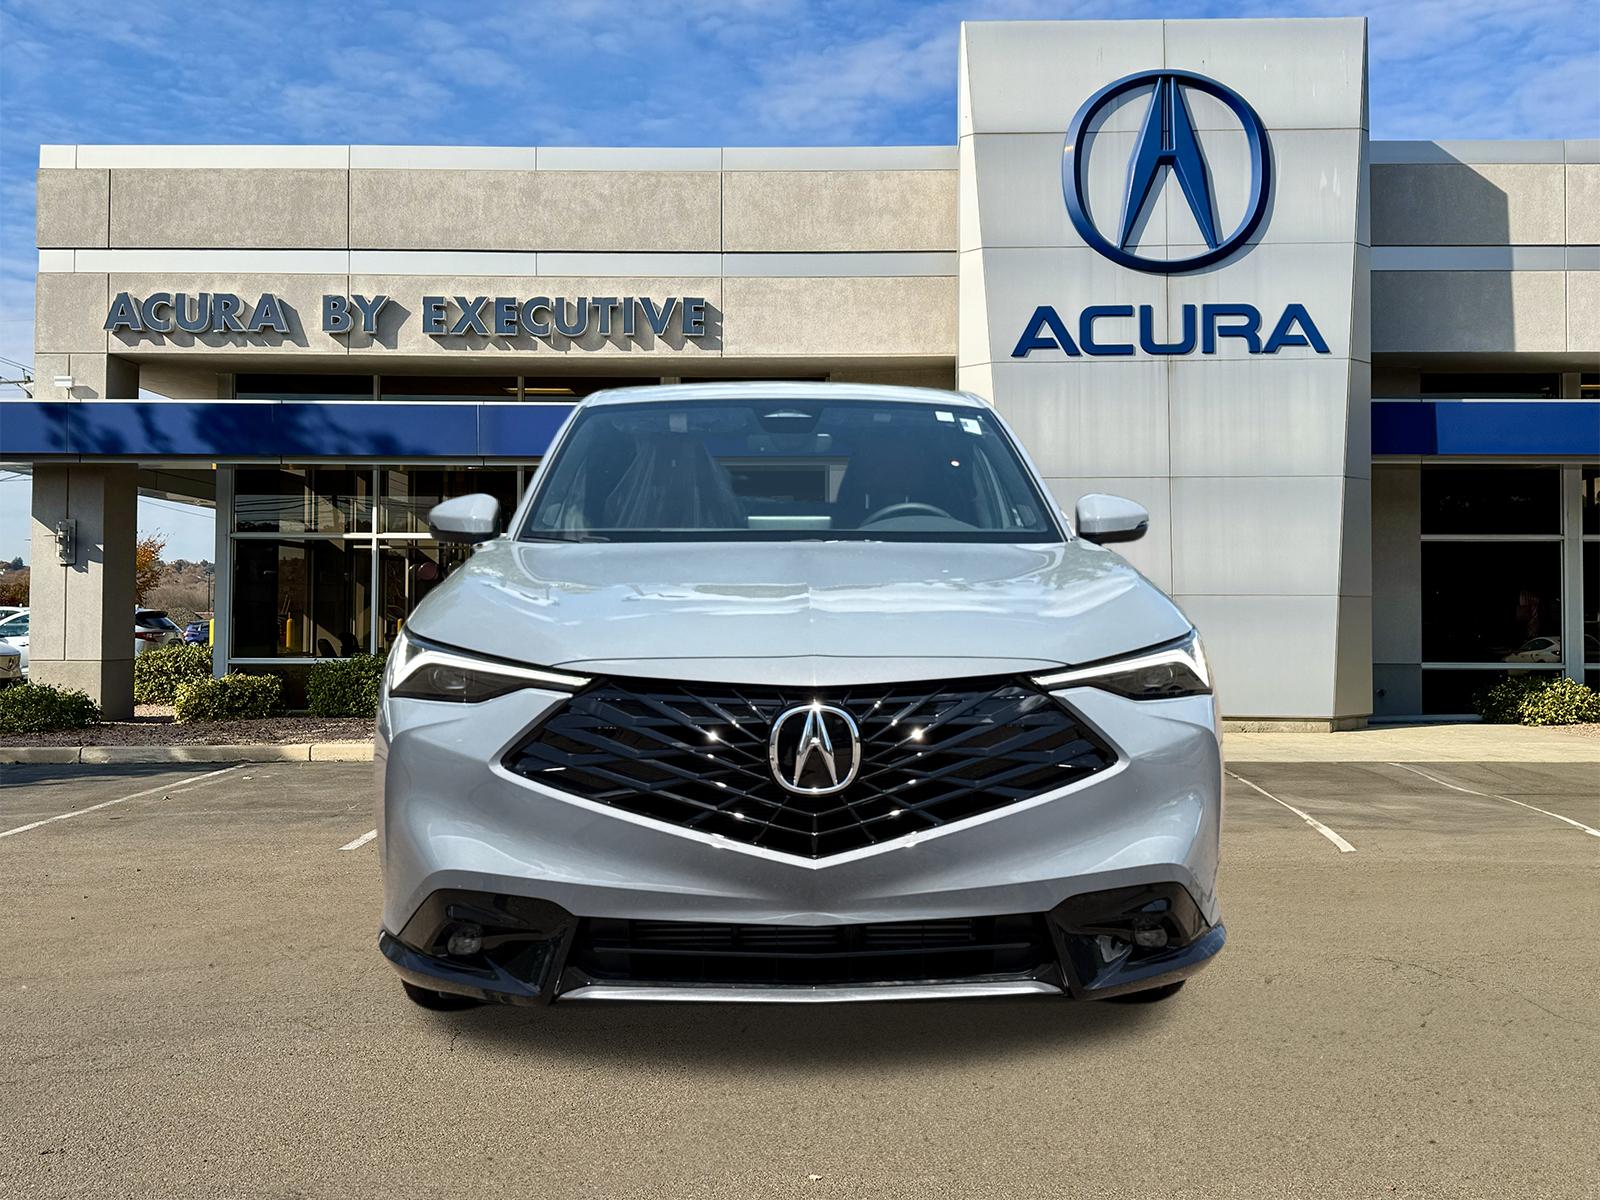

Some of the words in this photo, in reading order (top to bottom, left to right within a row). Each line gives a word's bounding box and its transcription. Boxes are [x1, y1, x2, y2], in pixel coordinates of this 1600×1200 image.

[103, 291, 290, 333] ACURA
[321, 294, 390, 334] BY
[422, 295, 707, 337] EXECUTIVE
[1010, 303, 1332, 357] ACURA
